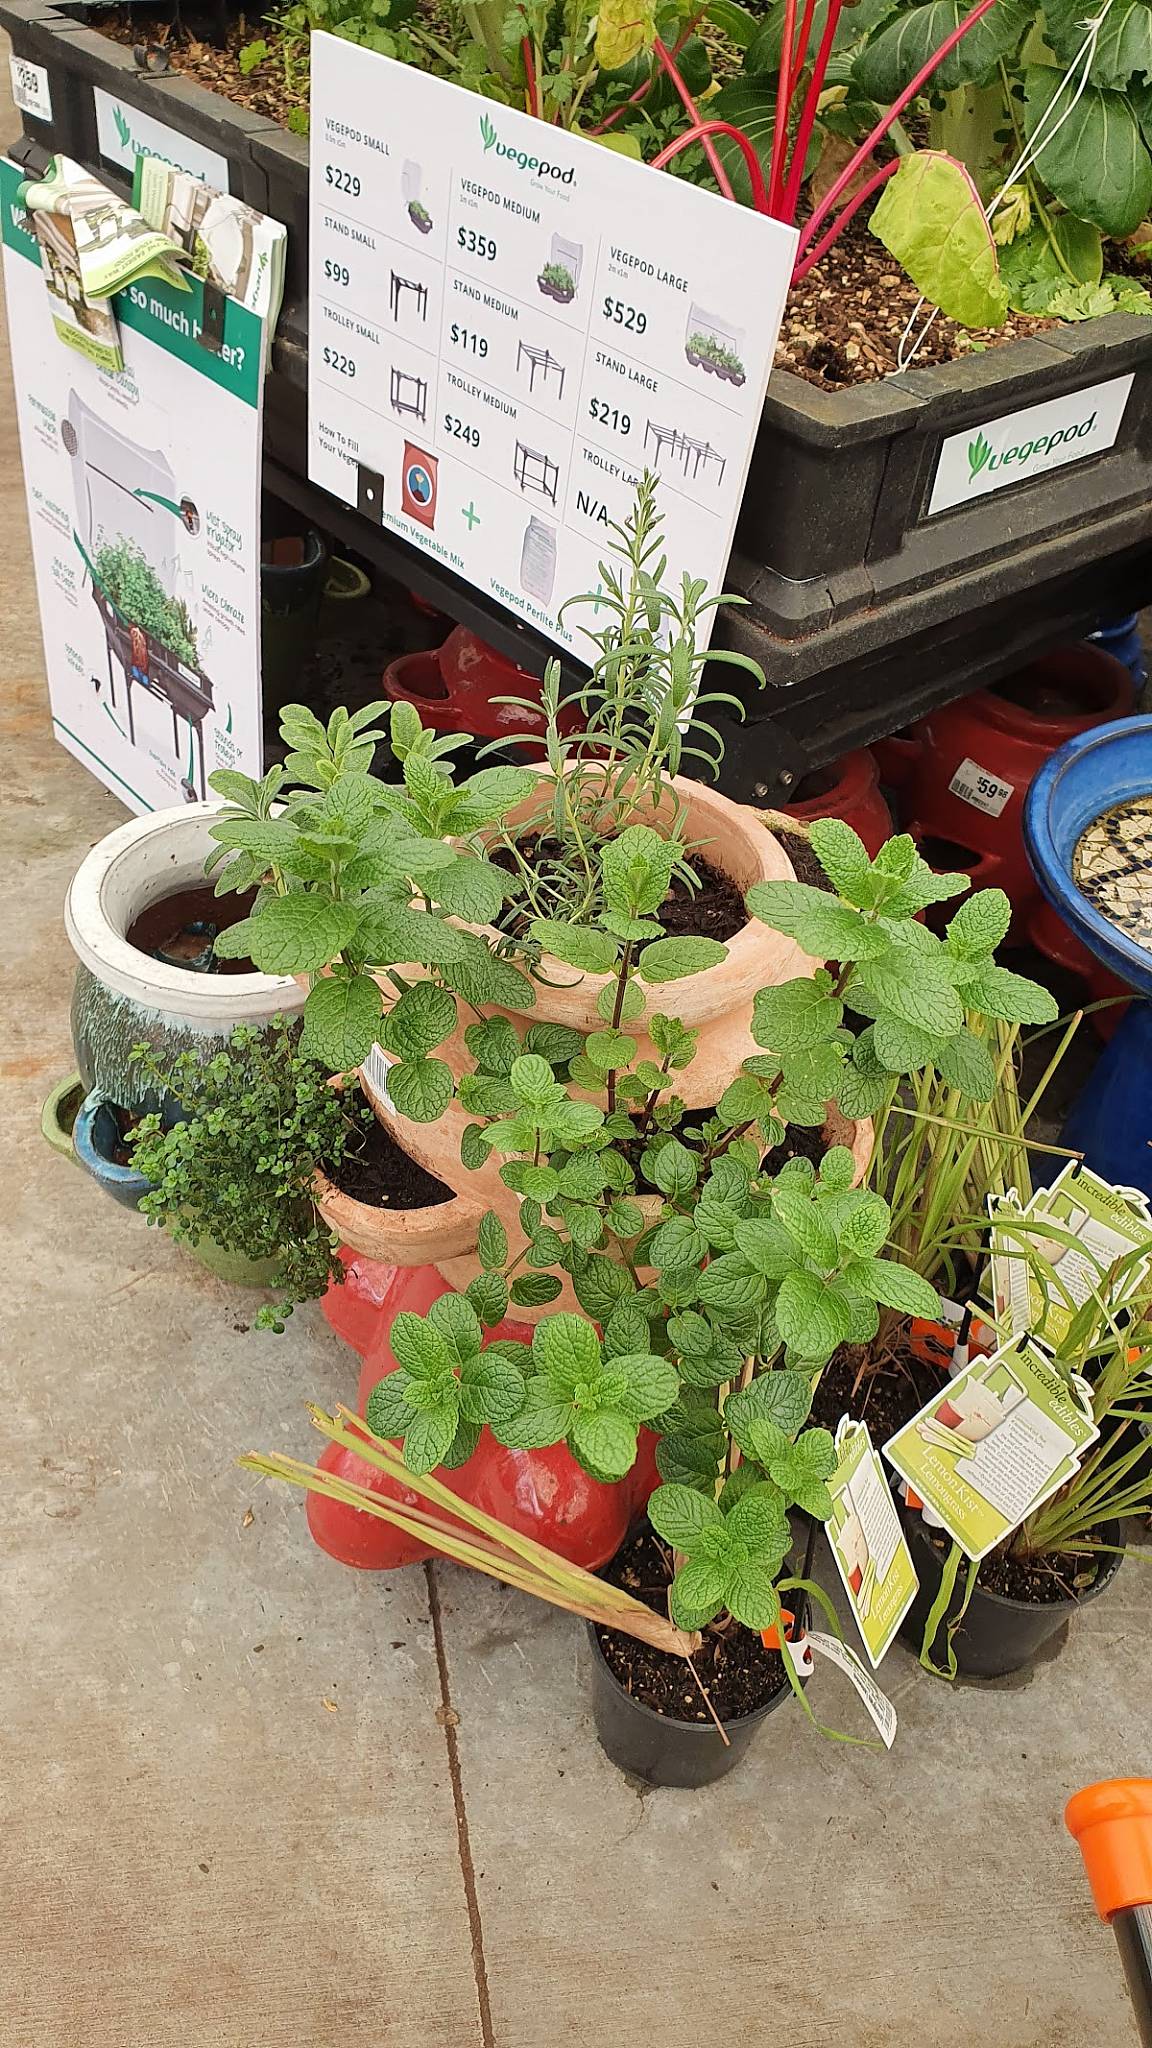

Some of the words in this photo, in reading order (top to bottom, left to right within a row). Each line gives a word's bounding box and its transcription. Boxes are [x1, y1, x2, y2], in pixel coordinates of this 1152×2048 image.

[325, 117, 361, 142] VEGEPOD
[364, 135, 390, 156] SMALL
[325, 164, 361, 198] $229
[495, 141, 575, 185] vegepod
[461, 178, 500, 205] VEGEPOD
[503, 197, 540, 224] MEDIUM
[324, 216, 349, 237] STAND
[350, 229, 376, 251] SMALL
[458, 226, 497, 260] $359
[324, 259, 350, 287] $99
[611, 246, 654, 276] VEGEPOD
[657, 268, 689, 293] LARGE
[130, 286, 147, 309] so
[150, 298, 189, 337] much
[454, 279, 481, 301] STAND
[483, 295, 518, 320] MEDIUM
[602, 296, 647, 335] $529
[323, 306, 353, 330] TROLLEY
[354, 324, 380, 345] SMALL
[450, 323, 488, 358] $119
[323, 346, 356, 378] $229
[595, 351, 626, 375] STAND
[628, 368, 659, 393] LARGE
[447, 372, 481, 399] TROLLEY
[483, 391, 517, 419] MEDIUM
[444, 413, 480, 448] $249
[589, 397, 631, 435] $219
[319, 421, 335, 438] How
[336, 431, 346, 444] To
[347, 438, 359, 453] Fill
[319, 436, 336, 454] Your
[988, 411, 1097, 471] vegepod
[583, 447, 620, 477] TROLLEY
[576, 490, 608, 527] N/A
[410, 526, 448, 559] Vegetable
[450, 552, 465, 570] Mix
[490, 578, 525, 610] Vegepod
[527, 602, 554, 630] Perlite
[554, 621, 574, 643] Plus
[1076, 1175, 1127, 1215] incredible
[1110, 1213, 1148, 1241] edibles
[1020, 1350, 1067, 1404] incredible
[1048, 1400, 1084, 1437] edibles
